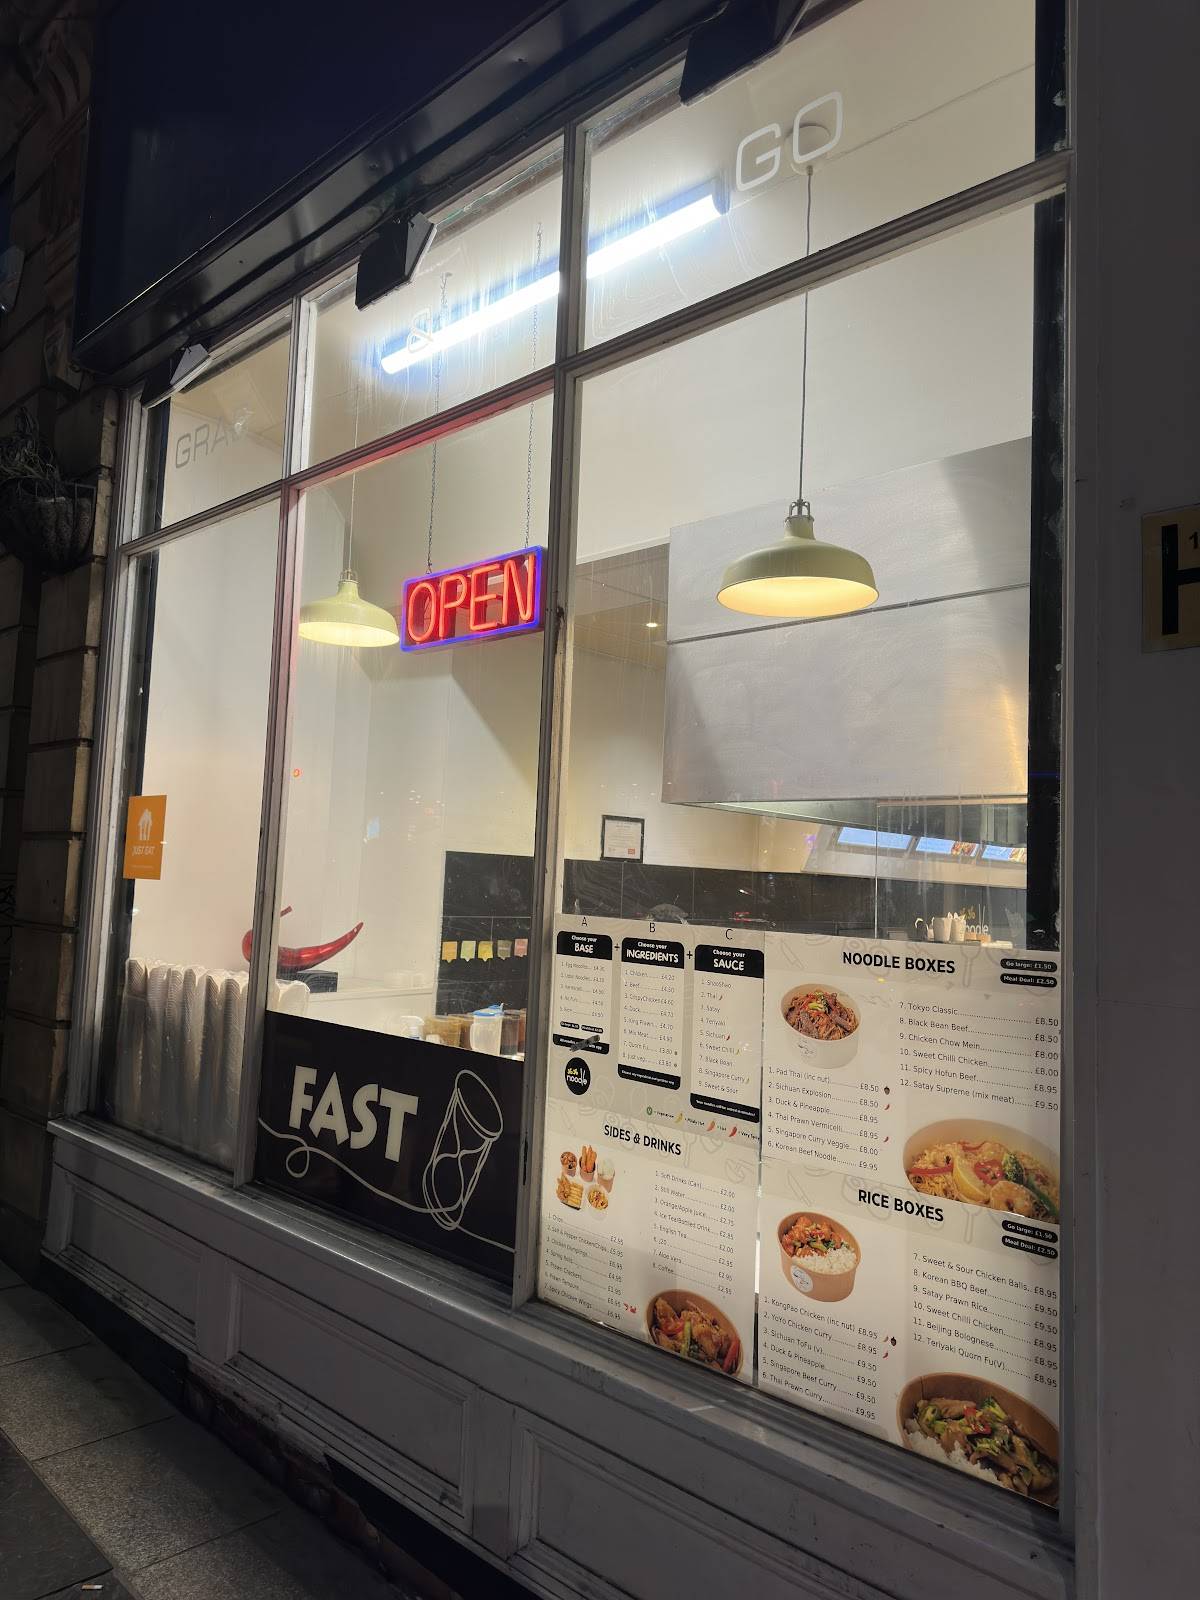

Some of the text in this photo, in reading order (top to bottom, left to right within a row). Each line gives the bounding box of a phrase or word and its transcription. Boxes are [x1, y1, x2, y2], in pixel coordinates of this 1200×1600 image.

[735, 91, 843, 192] GO
[406, 553, 537, 643] OPEN
[582, 916, 588, 926] A
[650, 922, 656, 932] B
[571, 934, 586, 942] Choose
[726, 928, 733, 940] C
[574, 942, 594, 954] BASE
[626, 949, 679, 964] INGREDIENTS
[712, 949, 731, 957] Choose
[713, 958, 745, 970] SAUCE
[842, 952, 956, 974] NOODLE BOXES
[1003, 974, 1018, 982] Meal
[1036, 978, 1054, 986] £2.50
[908, 1018, 928, 1028] Black
[930, 1021, 949, 1030] Bean
[951, 1024, 968, 1032] Beef
[913, 1049, 936, 1060] Sweet
[958, 1056, 988, 1067] Chicken
[289, 1064, 418, 1163] FAST
[604, 1124, 681, 1156] SIDES & DRINKS
[858, 1189, 944, 1222] RICE BOXES
[922, 1255, 945, 1268] Sweet
[956, 1263, 974, 1274] Sour
[975, 1269, 1006, 1284] Chicken
[1008, 1279, 1028, 1290] Balls
[1034, 1286, 1057, 1299] £8.95
[922, 1271, 949, 1285] Korean
[970, 1285, 987, 1295] Beef
[922, 1287, 943, 1301] Satay
[945, 1294, 969, 1307] Prawn
[971, 1301, 988, 1312] Rice
[926, 1305, 950, 1319] Sweet
[972, 1319, 1004, 1335] Chicken
[926, 1321, 951, 1336] Beijing
[954, 1329, 994, 1349] Bolognese
[926, 1337, 956, 1353] Teriyaki
[958, 1348, 981, 1361] Quorn
